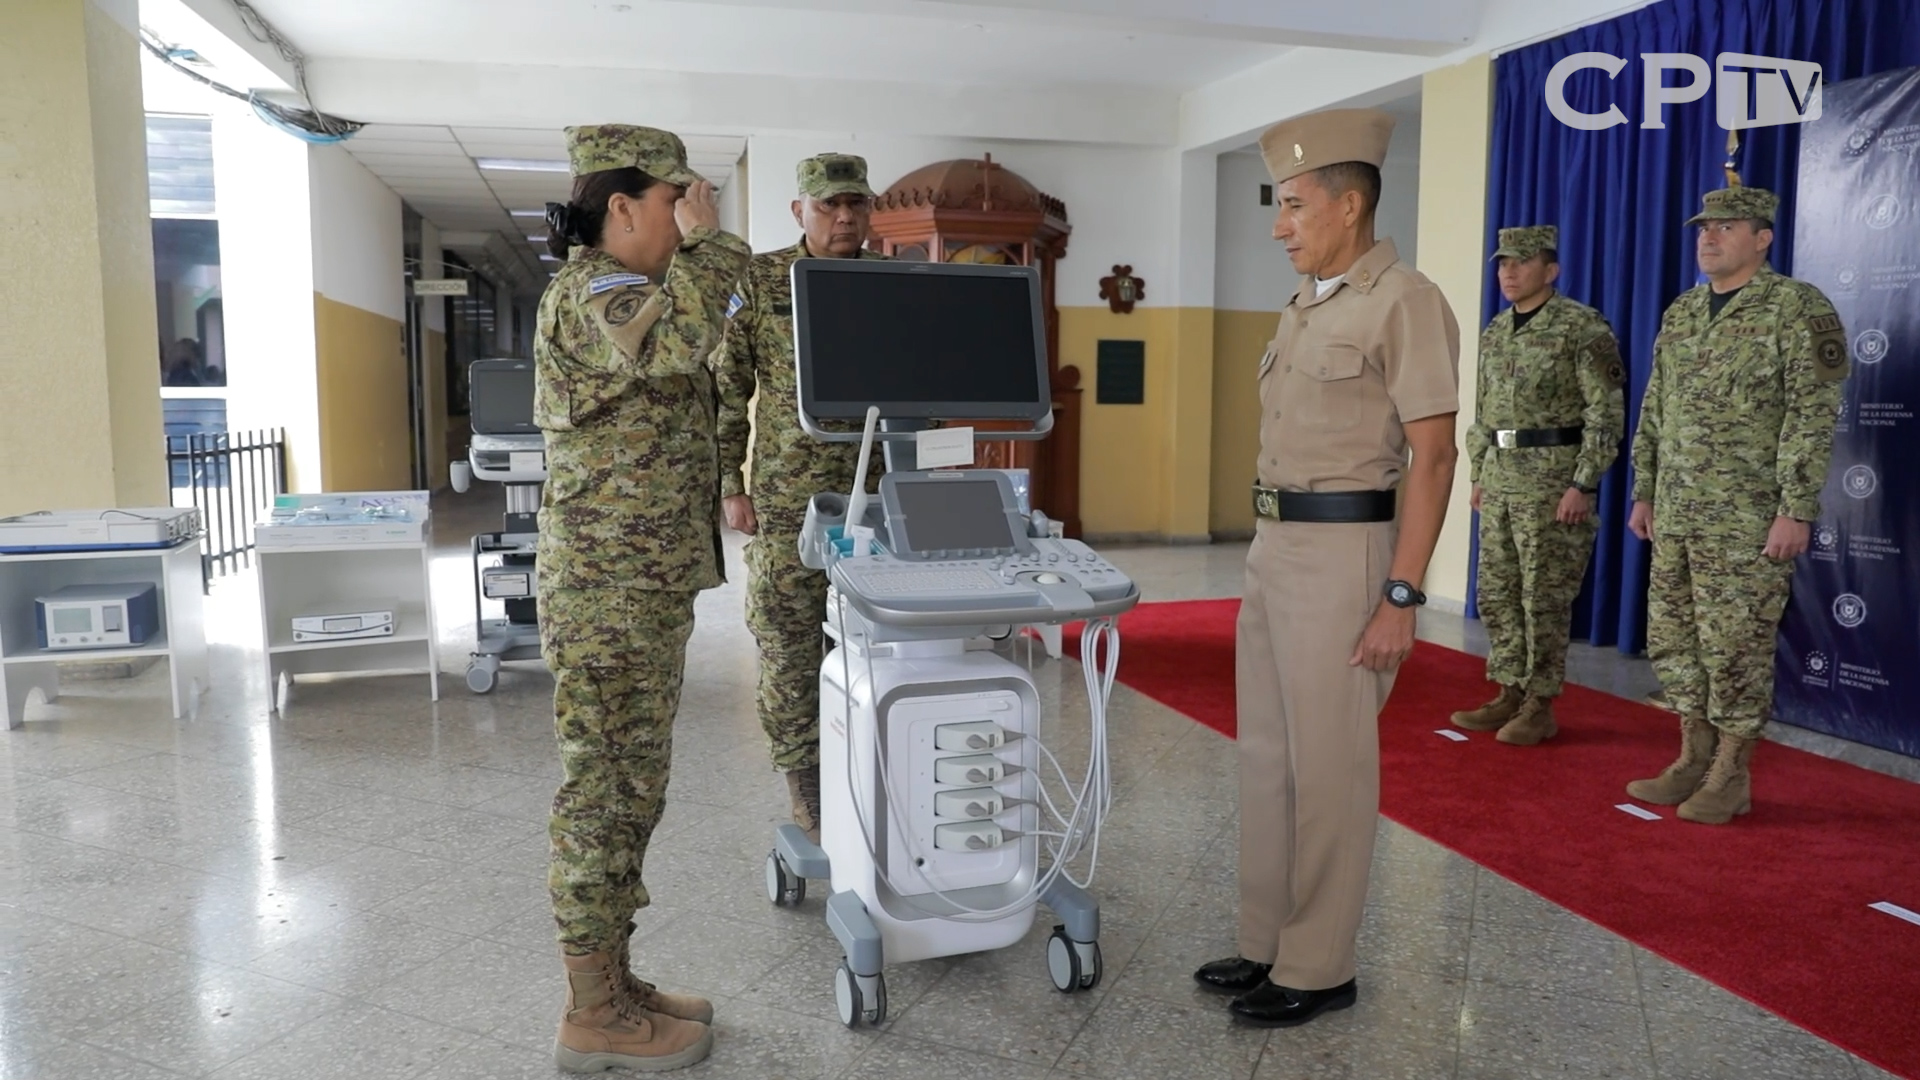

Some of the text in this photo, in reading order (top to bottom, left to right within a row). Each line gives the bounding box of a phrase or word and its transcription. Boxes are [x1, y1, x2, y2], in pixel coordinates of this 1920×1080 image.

[1840, 662, 1881, 675] MINISTERIO
[1838, 677, 1874, 691] NACIONAL
[1850, 671, 1859, 680] LA
[1859, 674, 1889, 686] DEFENSA
